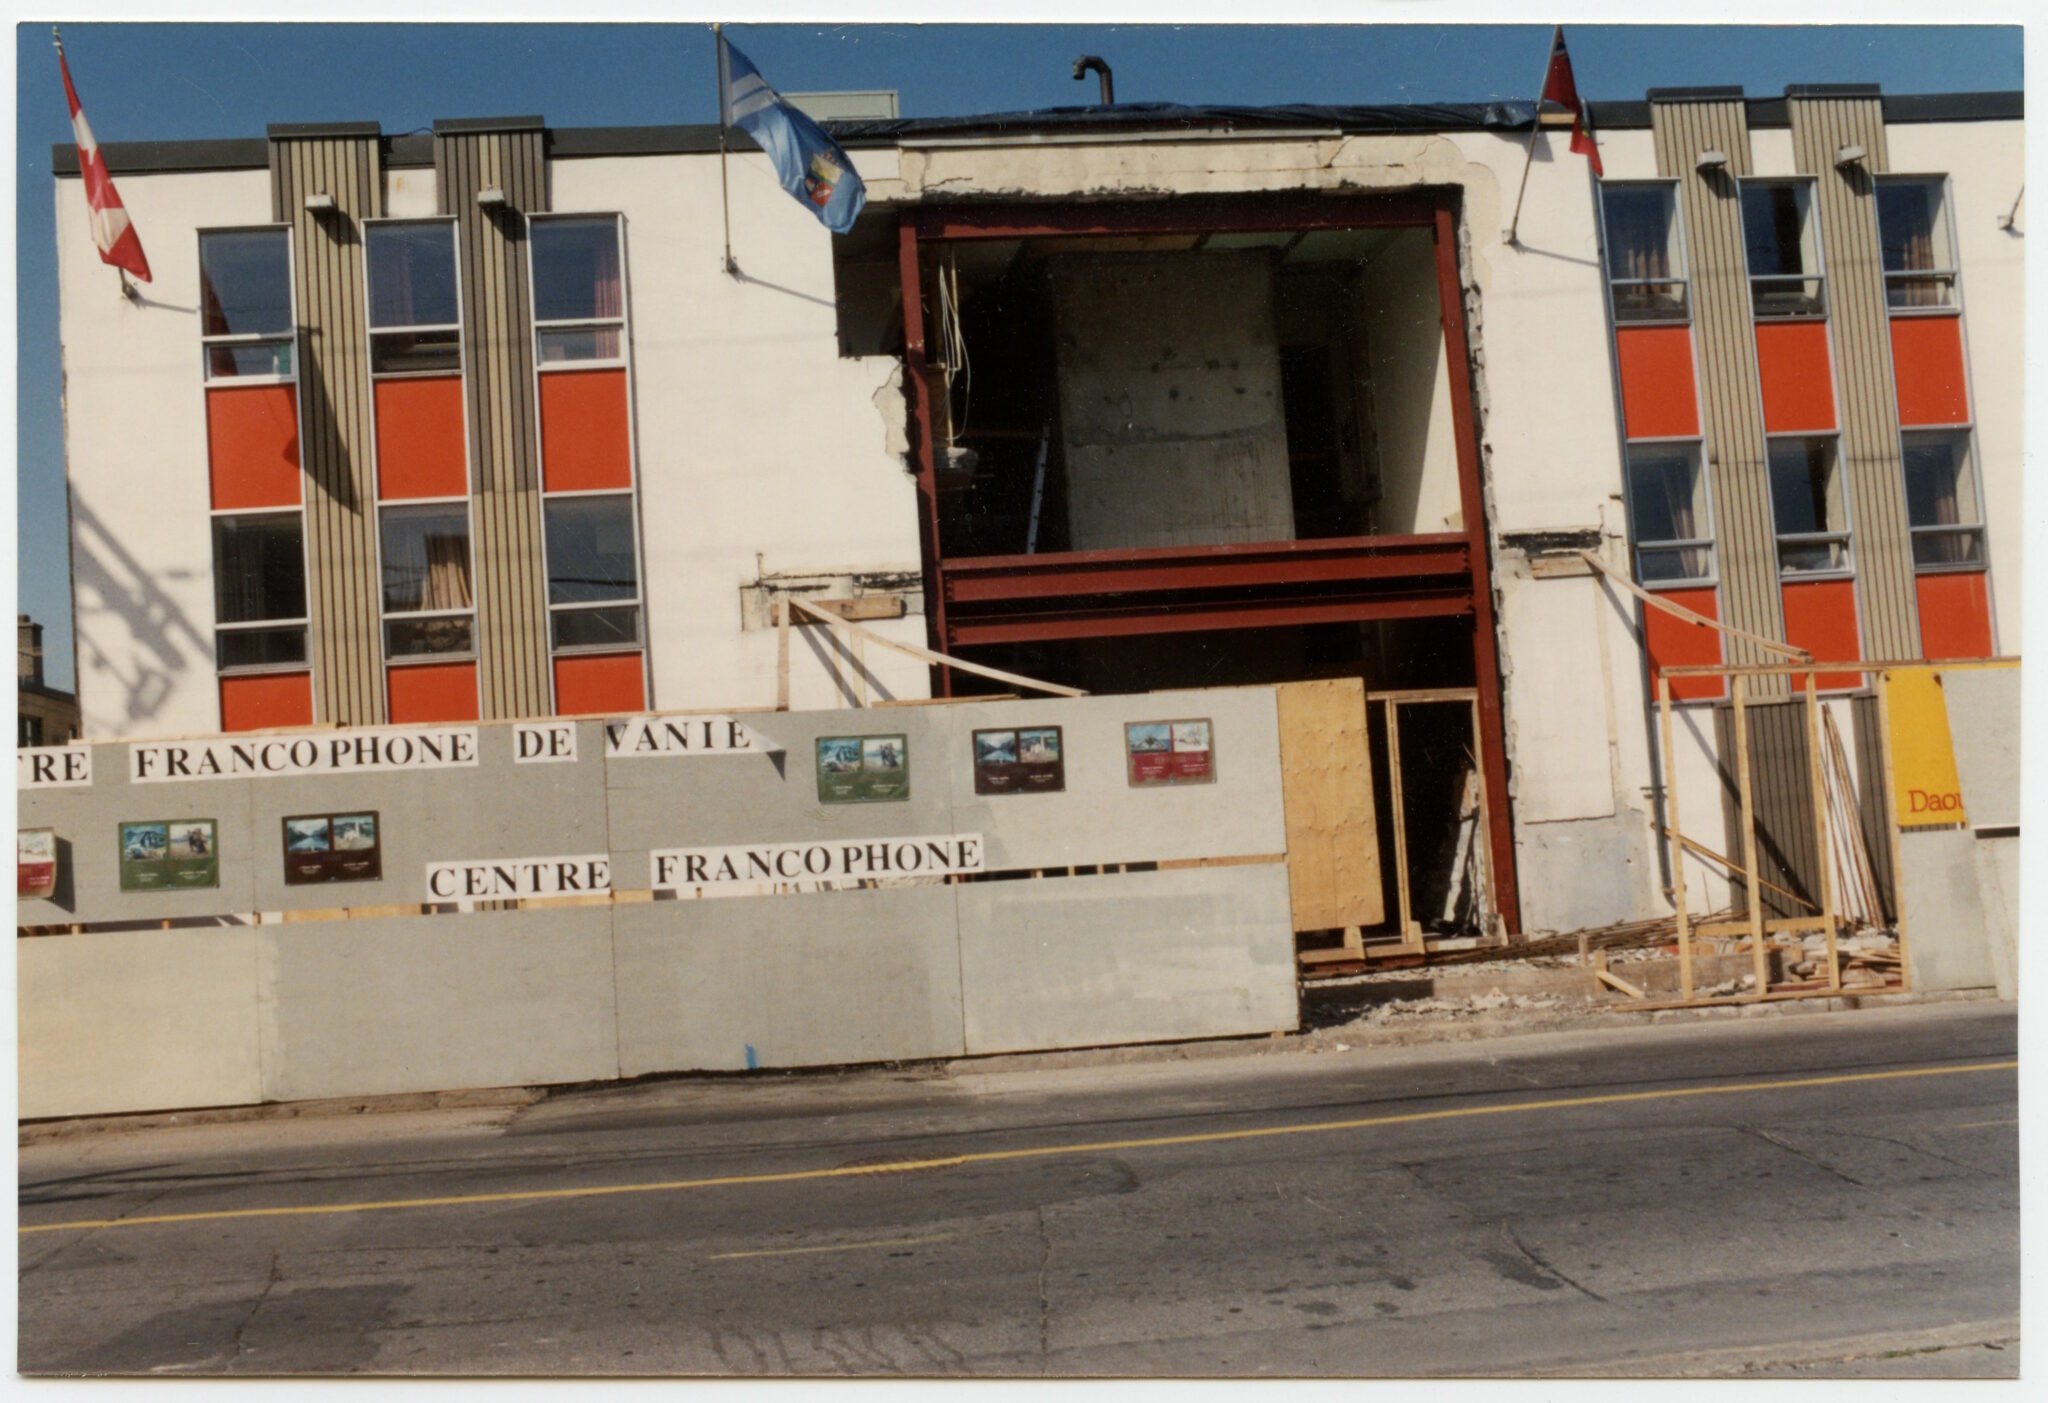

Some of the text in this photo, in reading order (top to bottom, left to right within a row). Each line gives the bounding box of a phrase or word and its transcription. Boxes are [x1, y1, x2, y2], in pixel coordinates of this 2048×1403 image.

[17, 753, 88, 783] RE
[135, 733, 475, 778] FRANCOPHONE
[518, 728, 571, 758] DE
[430, 839, 980, 897] CENTRE FRANCOPHONE
